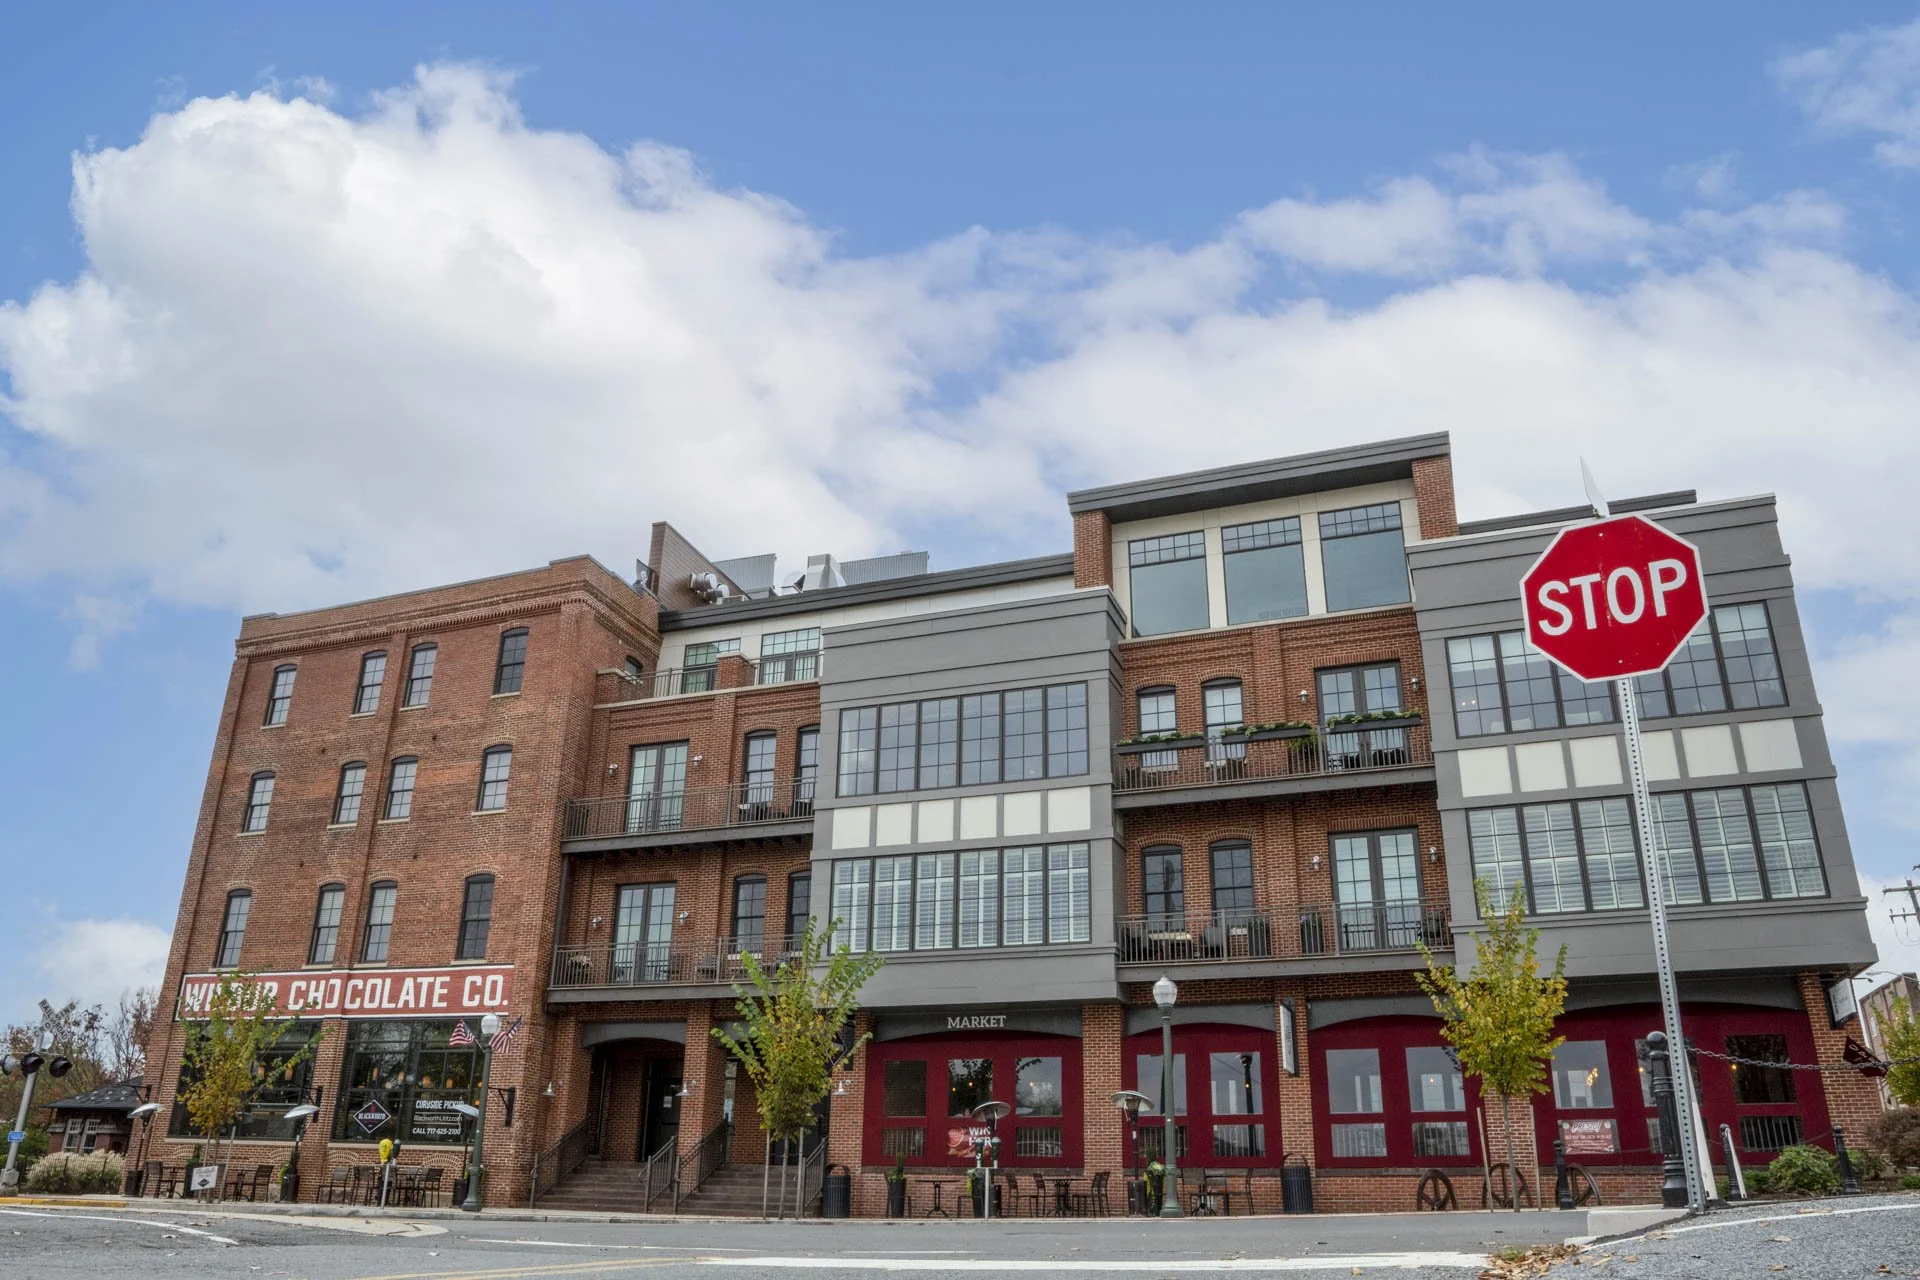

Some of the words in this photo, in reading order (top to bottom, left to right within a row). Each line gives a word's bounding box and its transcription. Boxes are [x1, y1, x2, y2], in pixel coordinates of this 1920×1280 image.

[1538, 558, 1688, 637] STOP
[287, 976, 450, 1010] CHOCOLATE
[462, 974, 508, 1007] CO.
[947, 1015, 1007, 1029] MARKET
